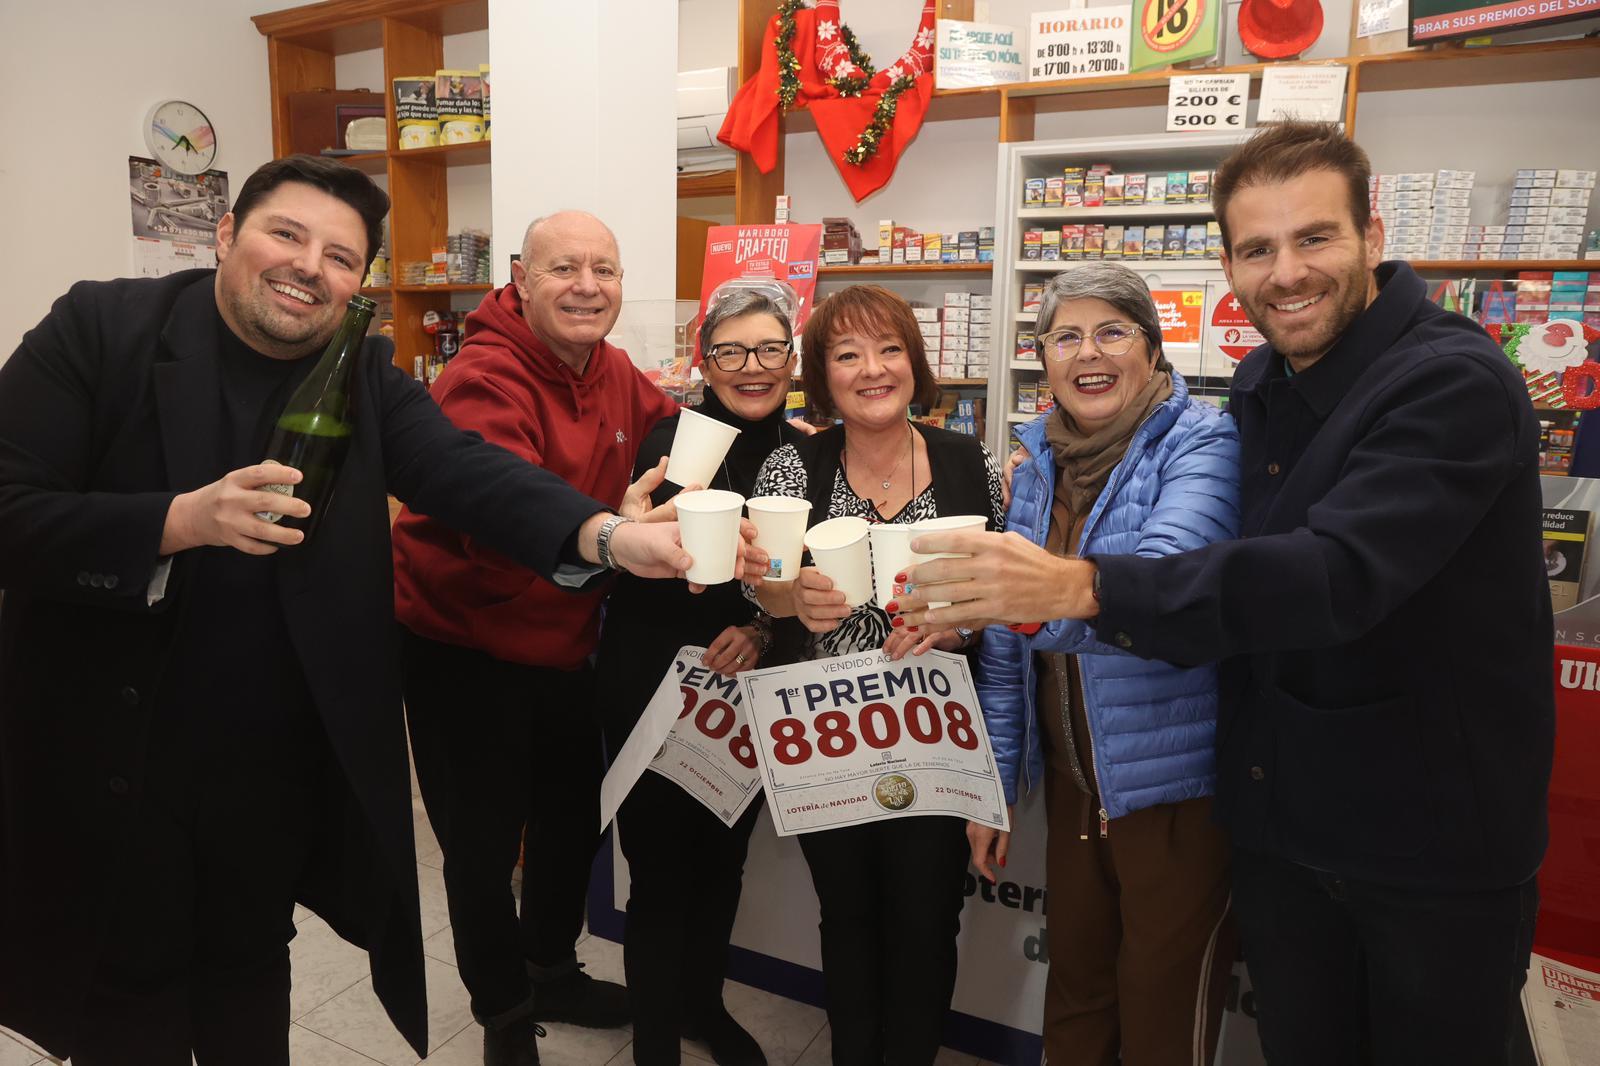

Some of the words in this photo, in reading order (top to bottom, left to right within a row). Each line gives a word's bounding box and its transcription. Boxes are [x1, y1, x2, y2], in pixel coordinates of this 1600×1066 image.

[1452, 16, 1476, 28] SUS
[1479, 6, 1536, 23] PREMIOS
[1539, 1, 1563, 13] DEL
[1039, 16, 1124, 34] HORARIO
[1038, 49, 1045, 58] DE
[1032, 67, 1040, 77] DE
[1174, 95, 1218, 107] 200
[1227, 95, 1241, 106] €
[1174, 115, 1217, 126] 500
[1225, 114, 1240, 125] €
[738, 229, 790, 238] MARLBORO
[712, 243, 732, 253] NUEVO
[735, 238, 788, 264] CRAFTED
[1547, 512, 1574, 521] reduce
[1542, 521, 1565, 529] ilidad
[821, 657, 873, 673] VENDIDO
[804, 666, 951, 712] PREMIO
[770, 696, 979, 765] 88008
[680, 760, 688, 768] 22
[689, 766, 724, 796] DICIEMBRE
[847, 770, 868, 778] MAYOR
[869, 765, 890, 774] SUERTE
[946, 788, 982, 801] DICIEMBRE
[786, 803, 820, 814] LOTERÍA
[830, 795, 868, 808] NAVIDAD
[964, 873, 1048, 914] oteri
